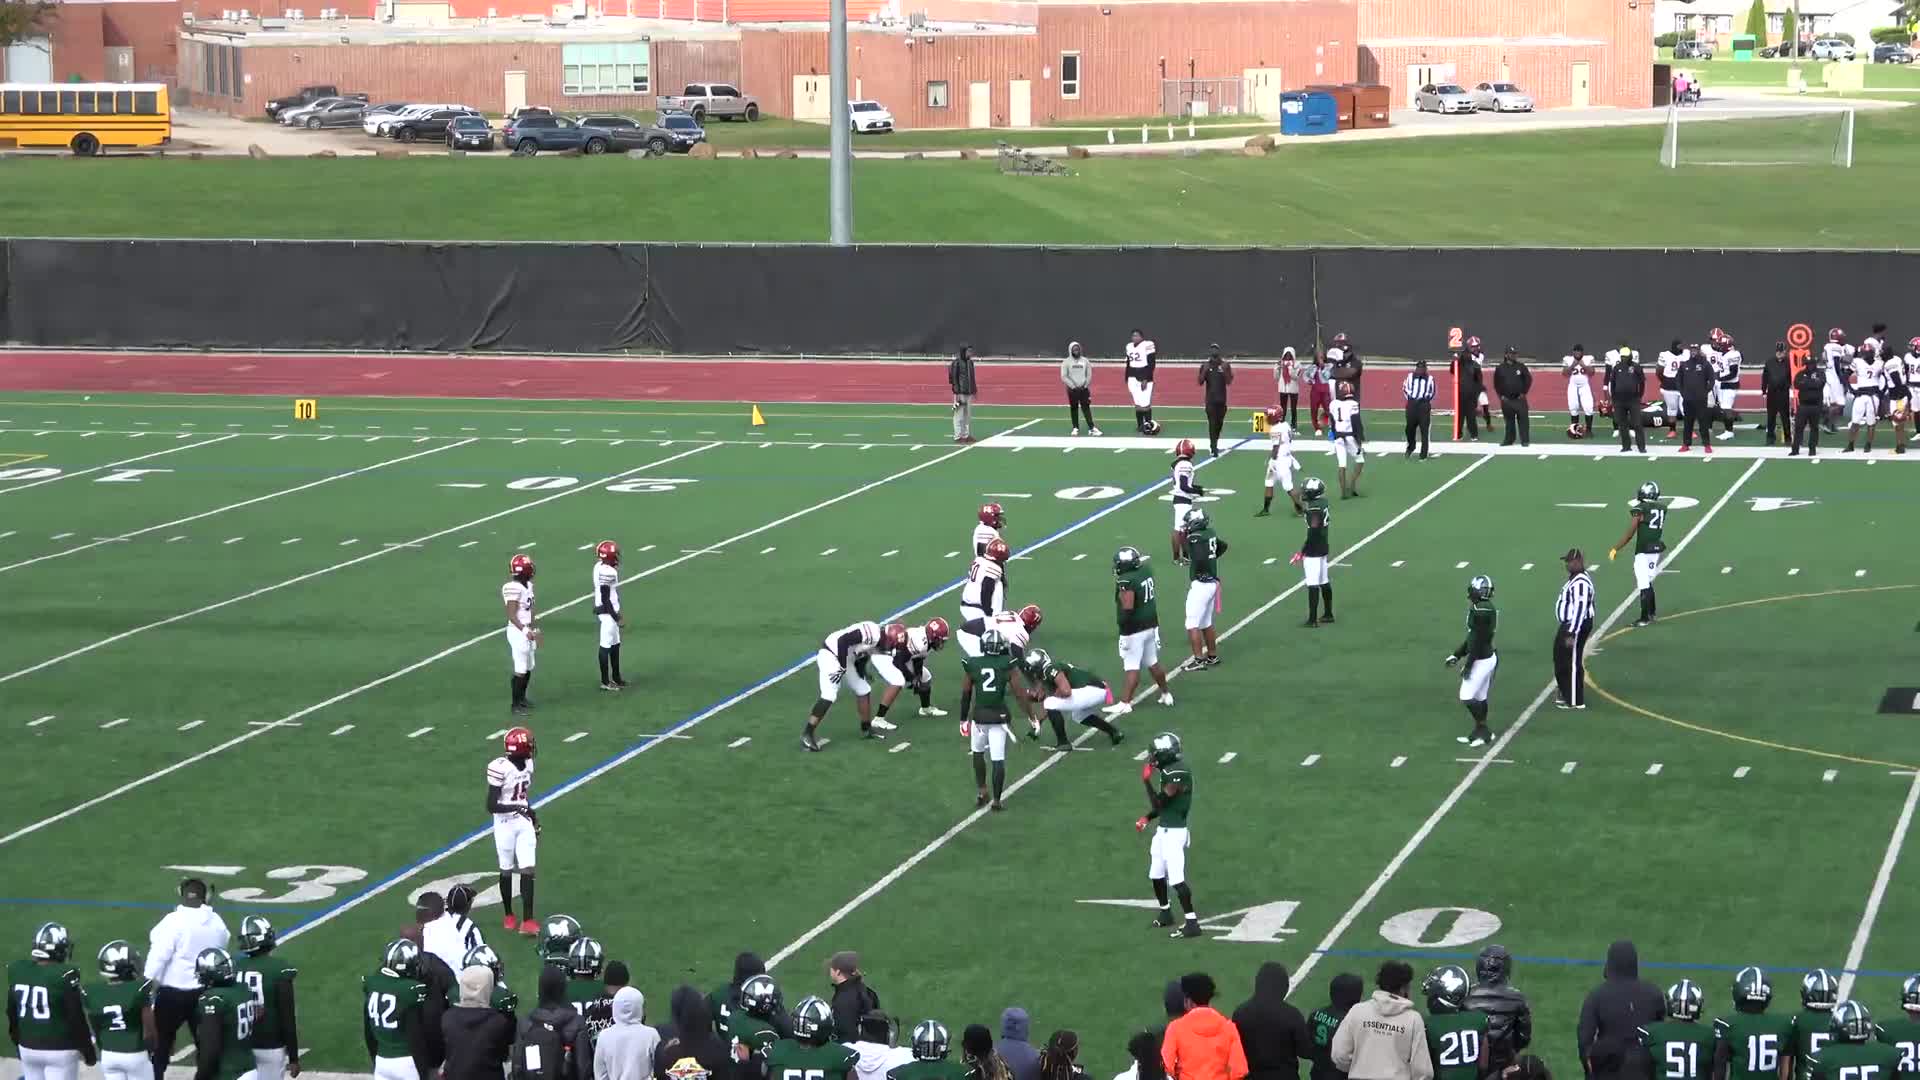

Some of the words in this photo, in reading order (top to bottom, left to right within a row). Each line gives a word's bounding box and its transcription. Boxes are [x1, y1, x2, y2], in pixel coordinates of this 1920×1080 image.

[1449, 327, 1463, 348] 2
[299, 402, 312, 419] 10
[1337, 407, 1343, 422] 1
[1255, 415, 1264, 432] 30
[1649, 509, 1665, 530] 21
[1140, 577, 1155, 603] 78
[981, 667, 997, 692] 2
[14, 983, 51, 1020] 70
[368, 991, 399, 1029] 42
[103, 1004, 127, 1031] 3
[1362, 1020, 1406, 1034] ESSENTIALS
[1440, 1030, 1480, 1065] 20
[1665, 1041, 1697, 1078] 51
[1747, 1034, 1778, 1071] 16
